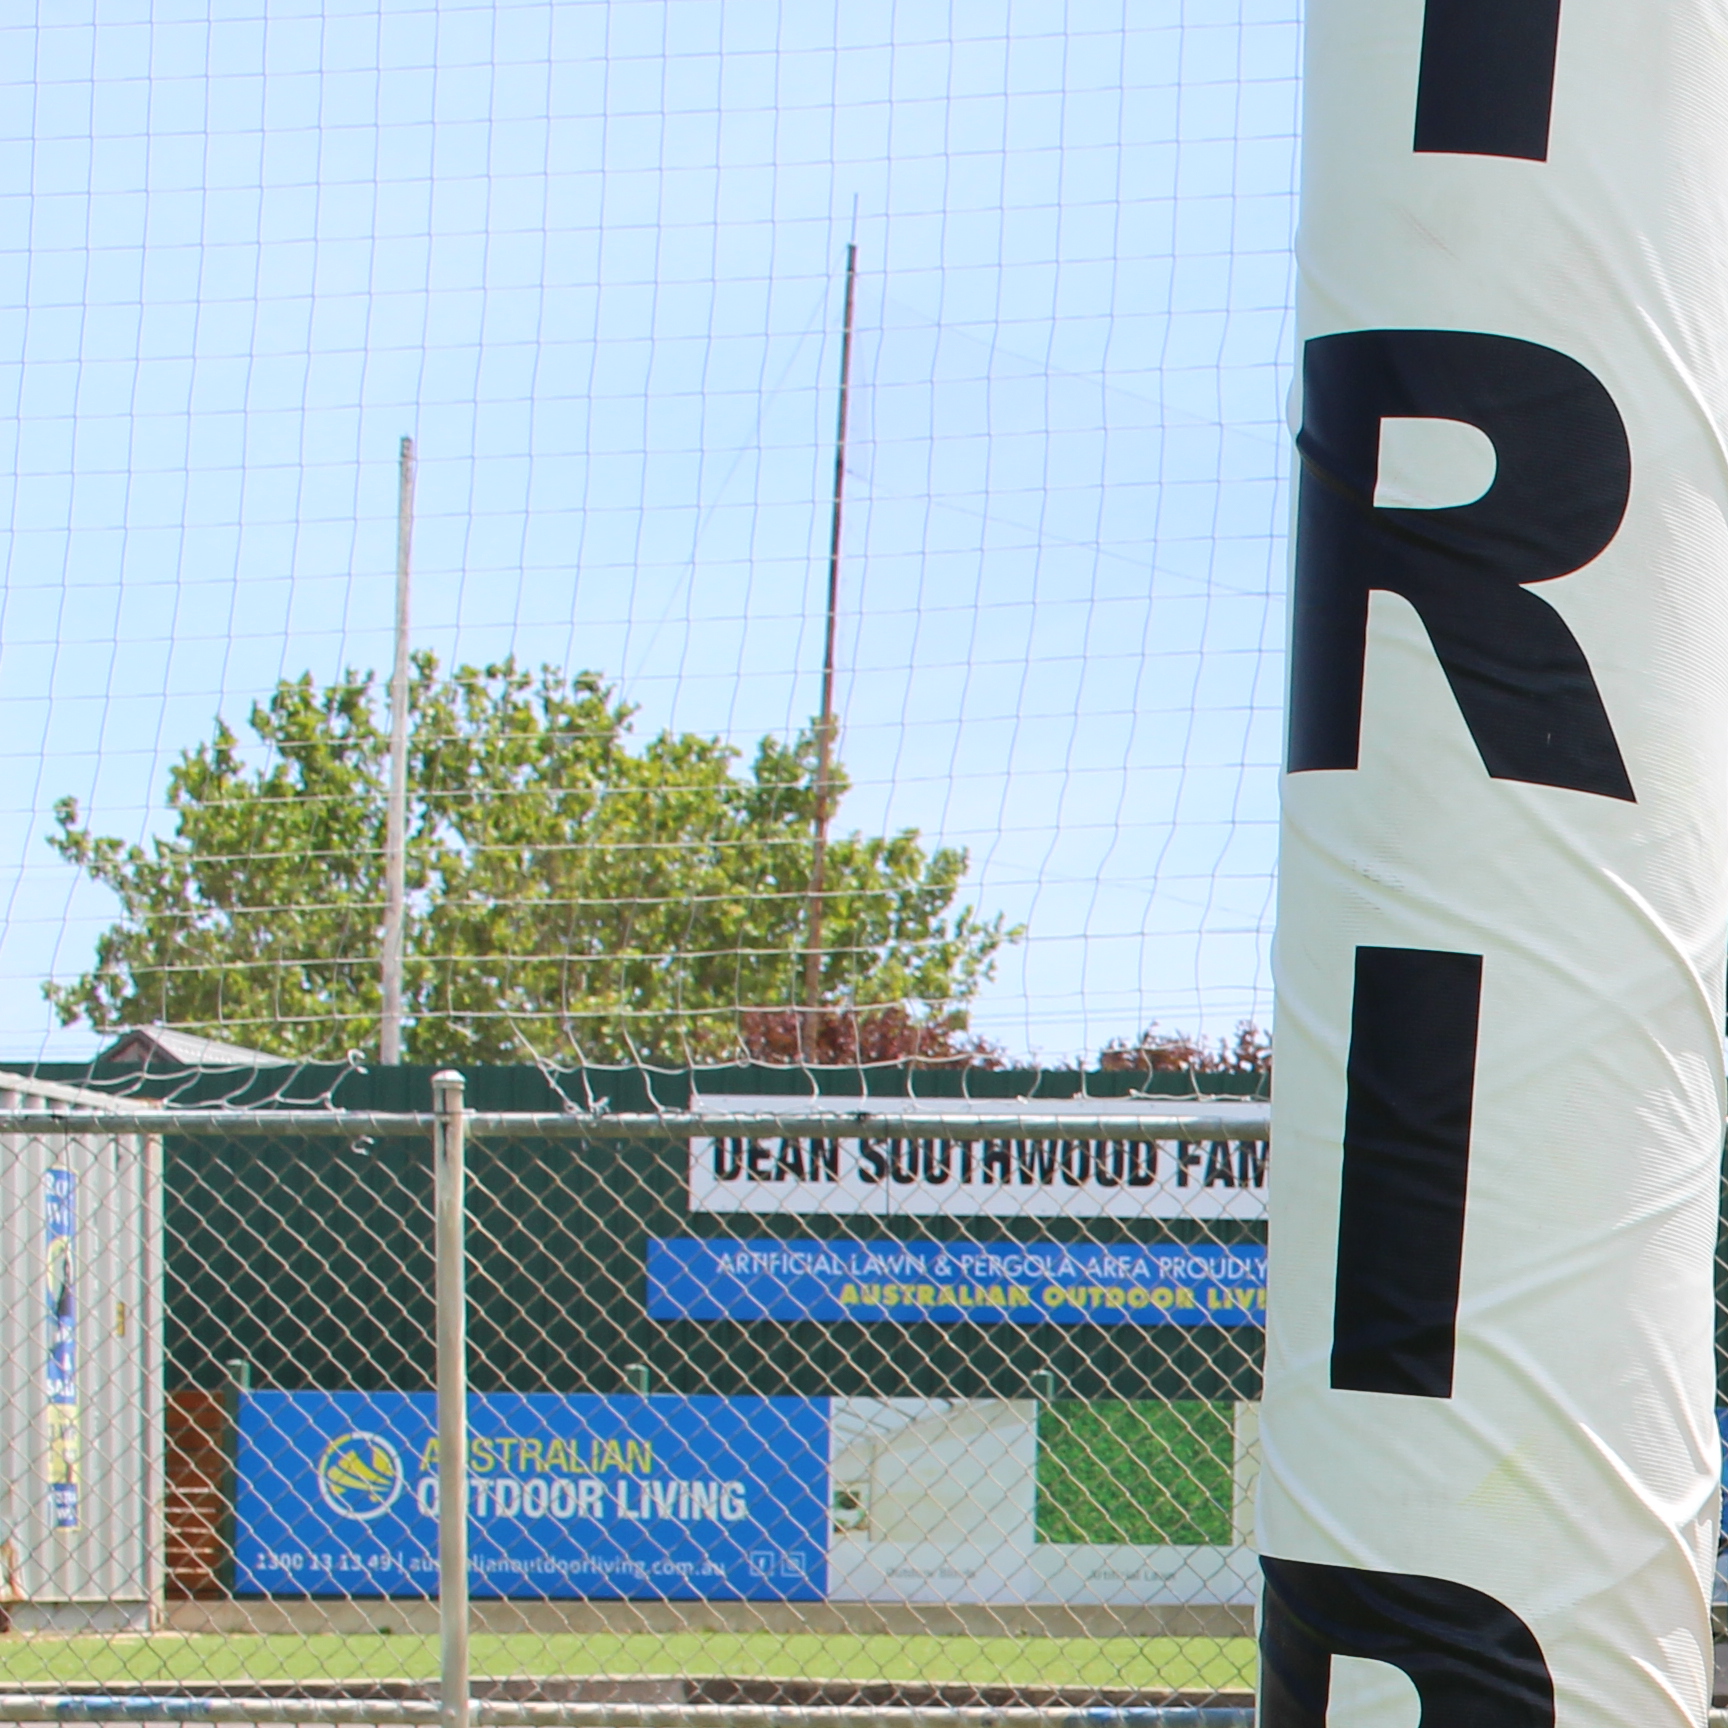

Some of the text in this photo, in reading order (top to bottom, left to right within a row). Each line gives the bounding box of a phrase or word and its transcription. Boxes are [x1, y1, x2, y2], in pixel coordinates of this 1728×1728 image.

[712, 1136, 840, 1184] DEAN
[858, 1137, 1159, 1188] SOUTHWOOD
[715, 1251, 1268, 1280] ARTIFICIAL LAWN & PERGOLA AREA PROUDLY
[839, 1284, 1032, 1308] AUSTRALIAN
[1041, 1285, 1195, 1310] OUTDOOR
[420, 1437, 653, 1474] ASTRALIAN
[416, 1478, 748, 1522] OTDOOR LIVING
[255, 1552, 304, 1571] 1300
[309, 1553, 333, 1571] 13
[367, 1553, 392, 1572] 49
